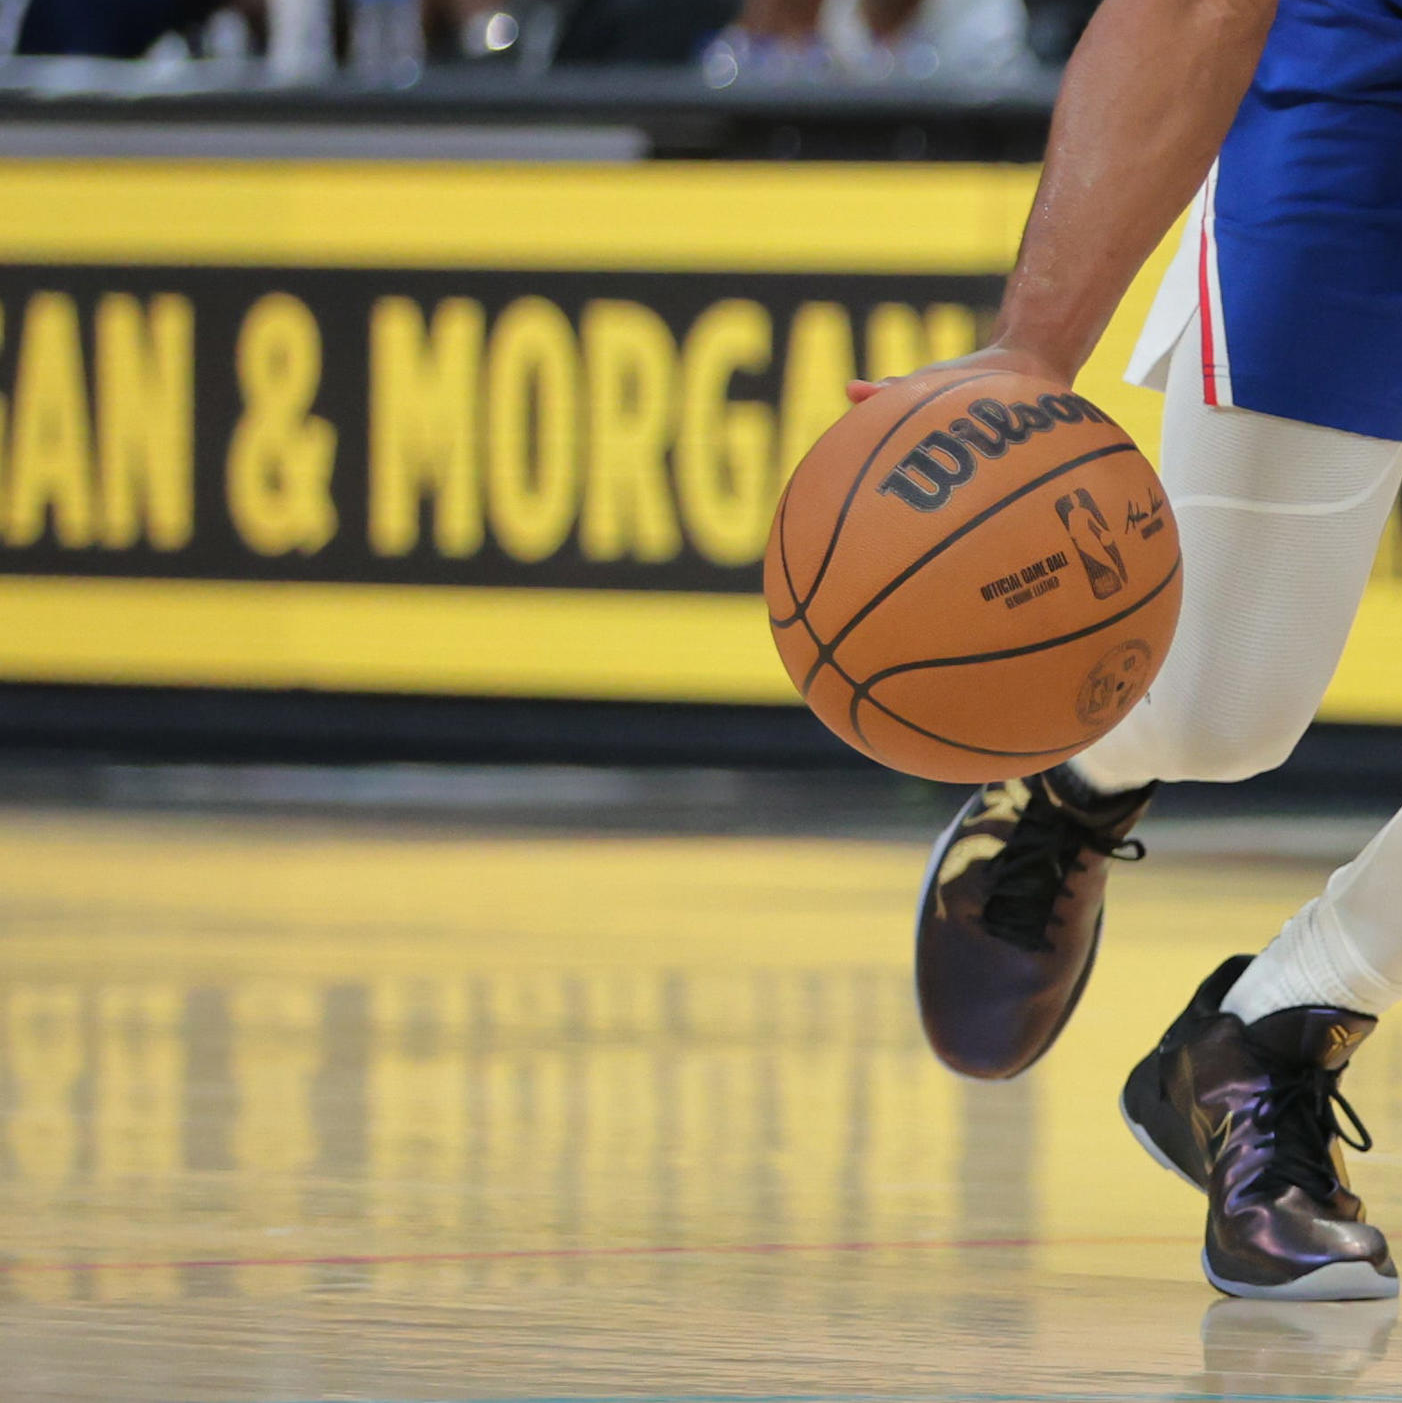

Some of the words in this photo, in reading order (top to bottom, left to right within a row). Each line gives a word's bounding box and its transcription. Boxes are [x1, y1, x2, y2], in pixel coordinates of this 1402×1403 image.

[0, 289, 196, 552] AN
[225, 291, 339, 558] &
[874, 392, 1120, 513] Wilson
[979, 572, 1023, 602] OFFICIAL
[1020, 561, 1050, 584] GAME
[1047, 550, 1069, 574] BALL
